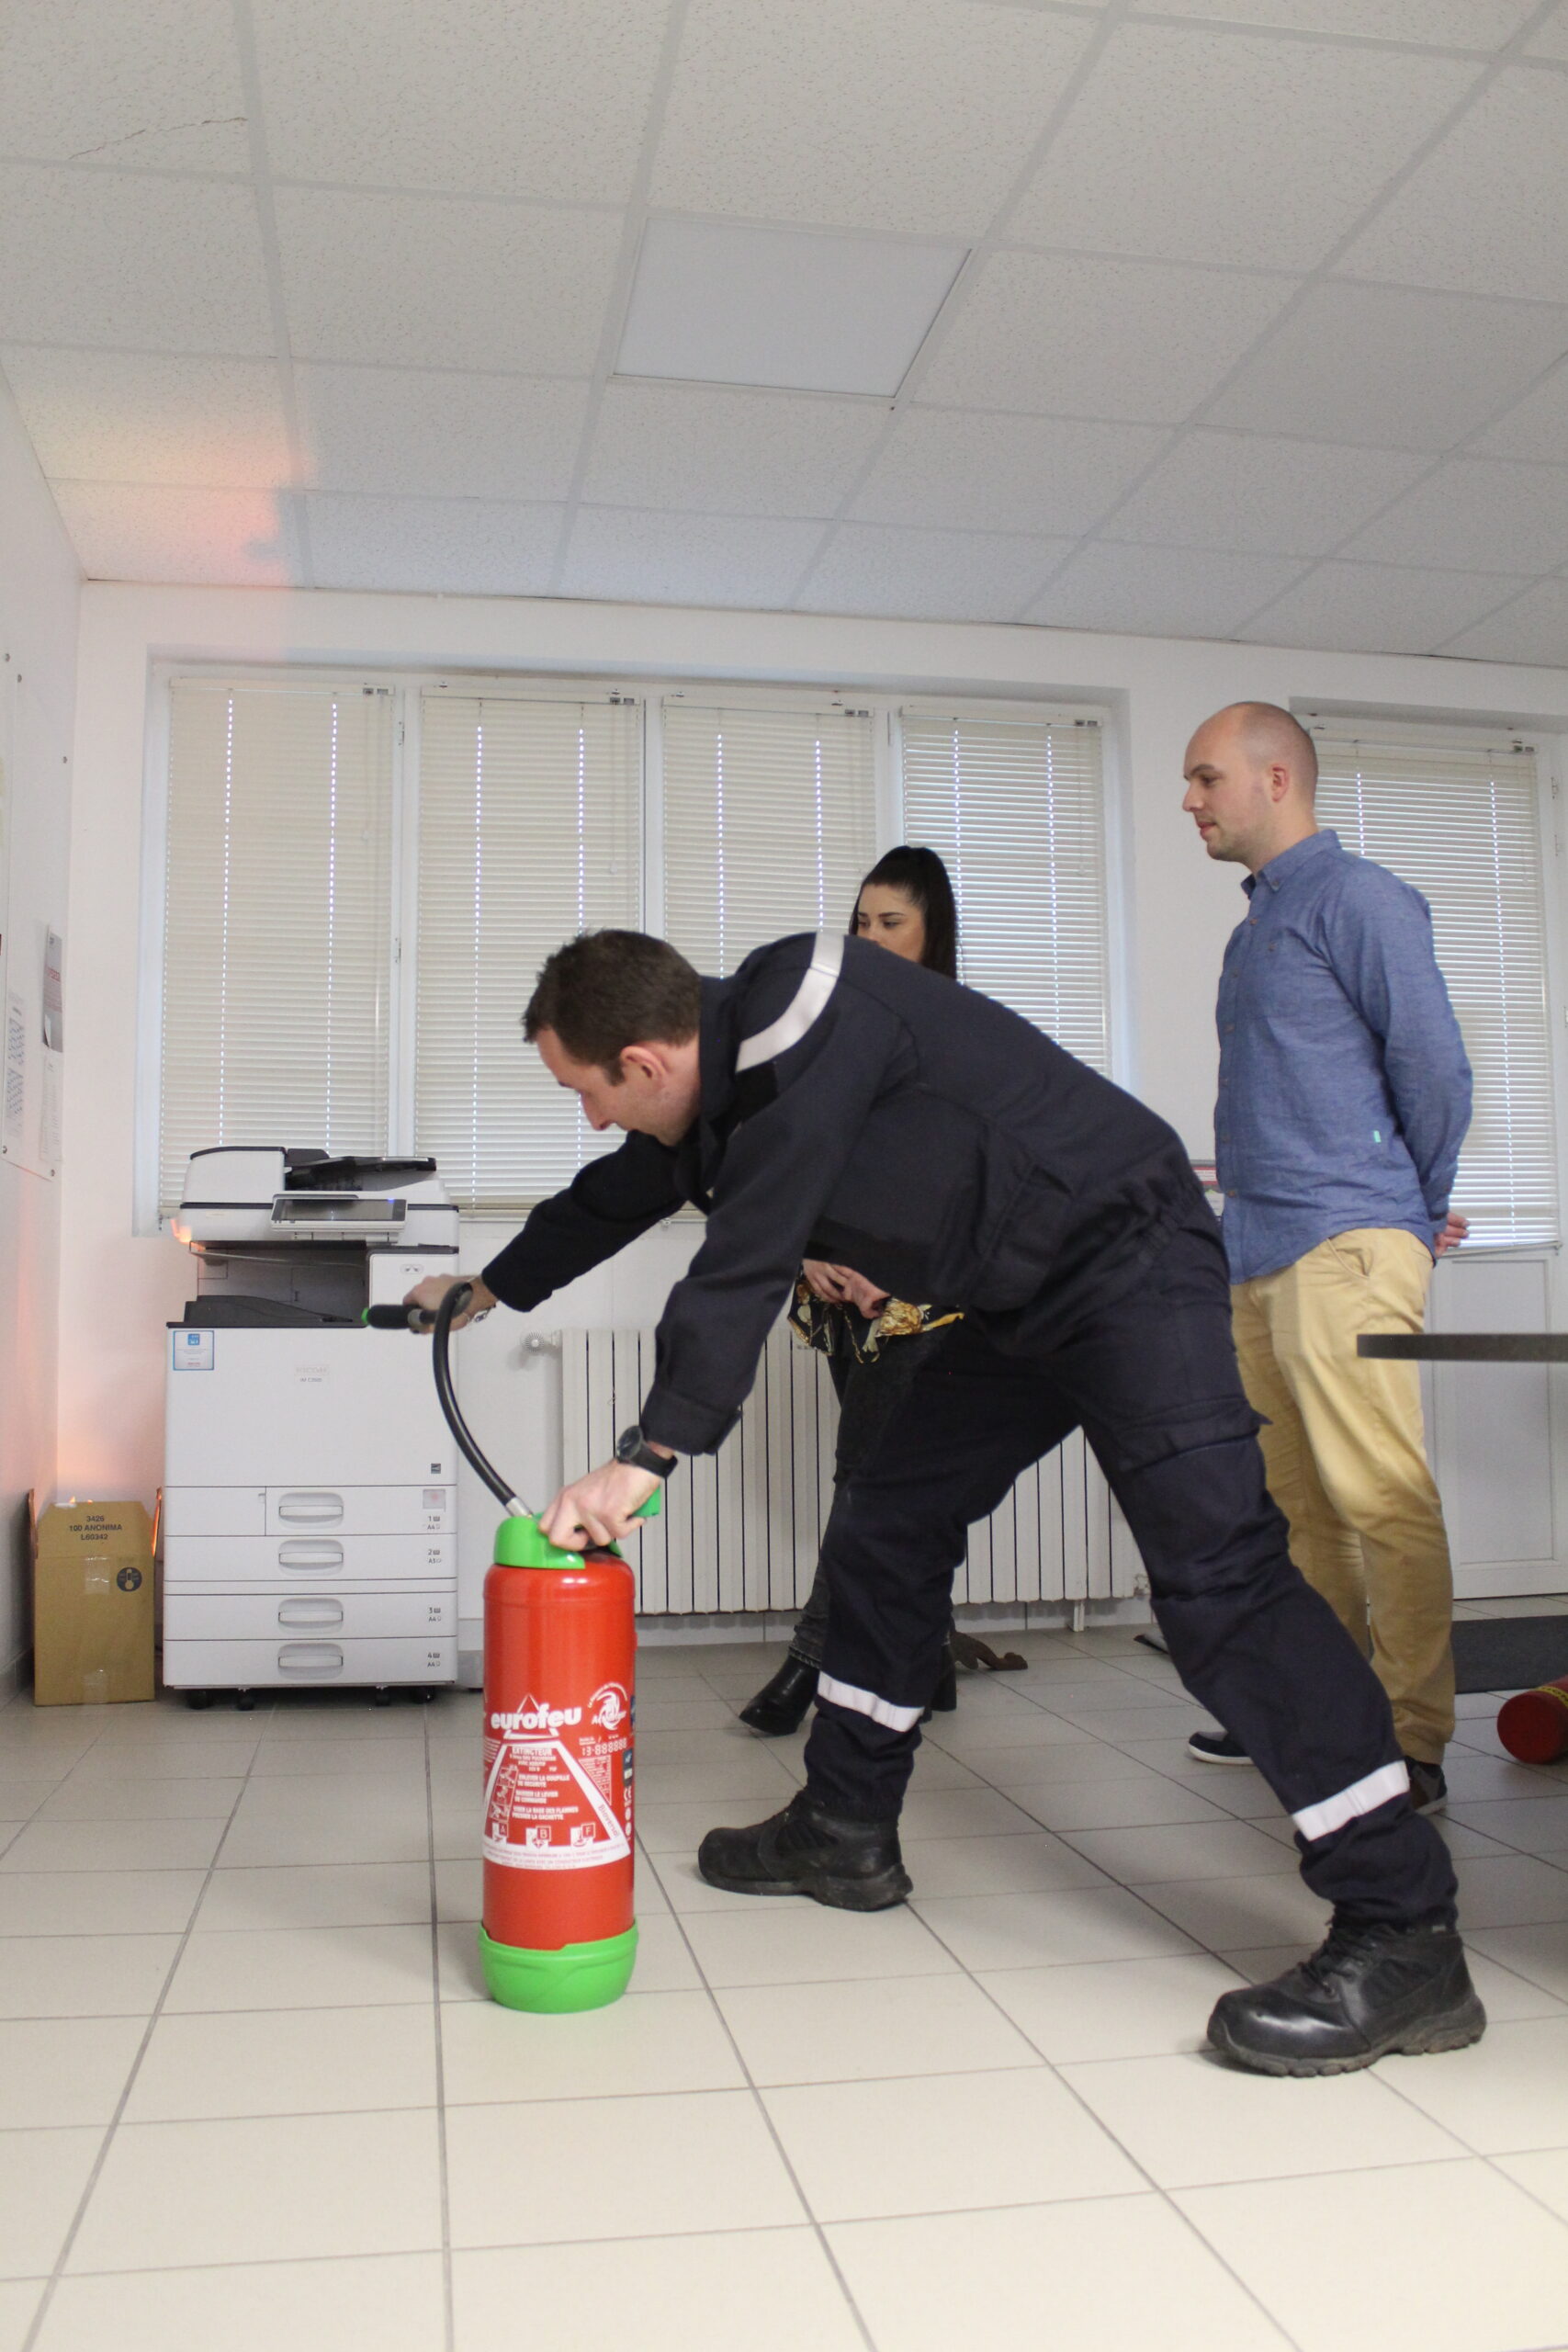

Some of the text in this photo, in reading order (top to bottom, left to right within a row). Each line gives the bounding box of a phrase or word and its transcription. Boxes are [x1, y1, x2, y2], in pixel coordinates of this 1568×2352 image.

[84, 1523, 123, 1532] ANONIMA
[491, 1702, 582, 1730] eurofeu
[512, 1746, 553, 1757] EXTINCTEUR
[539, 1828, 547, 1838] B
[586, 1826, 592, 1836] F
